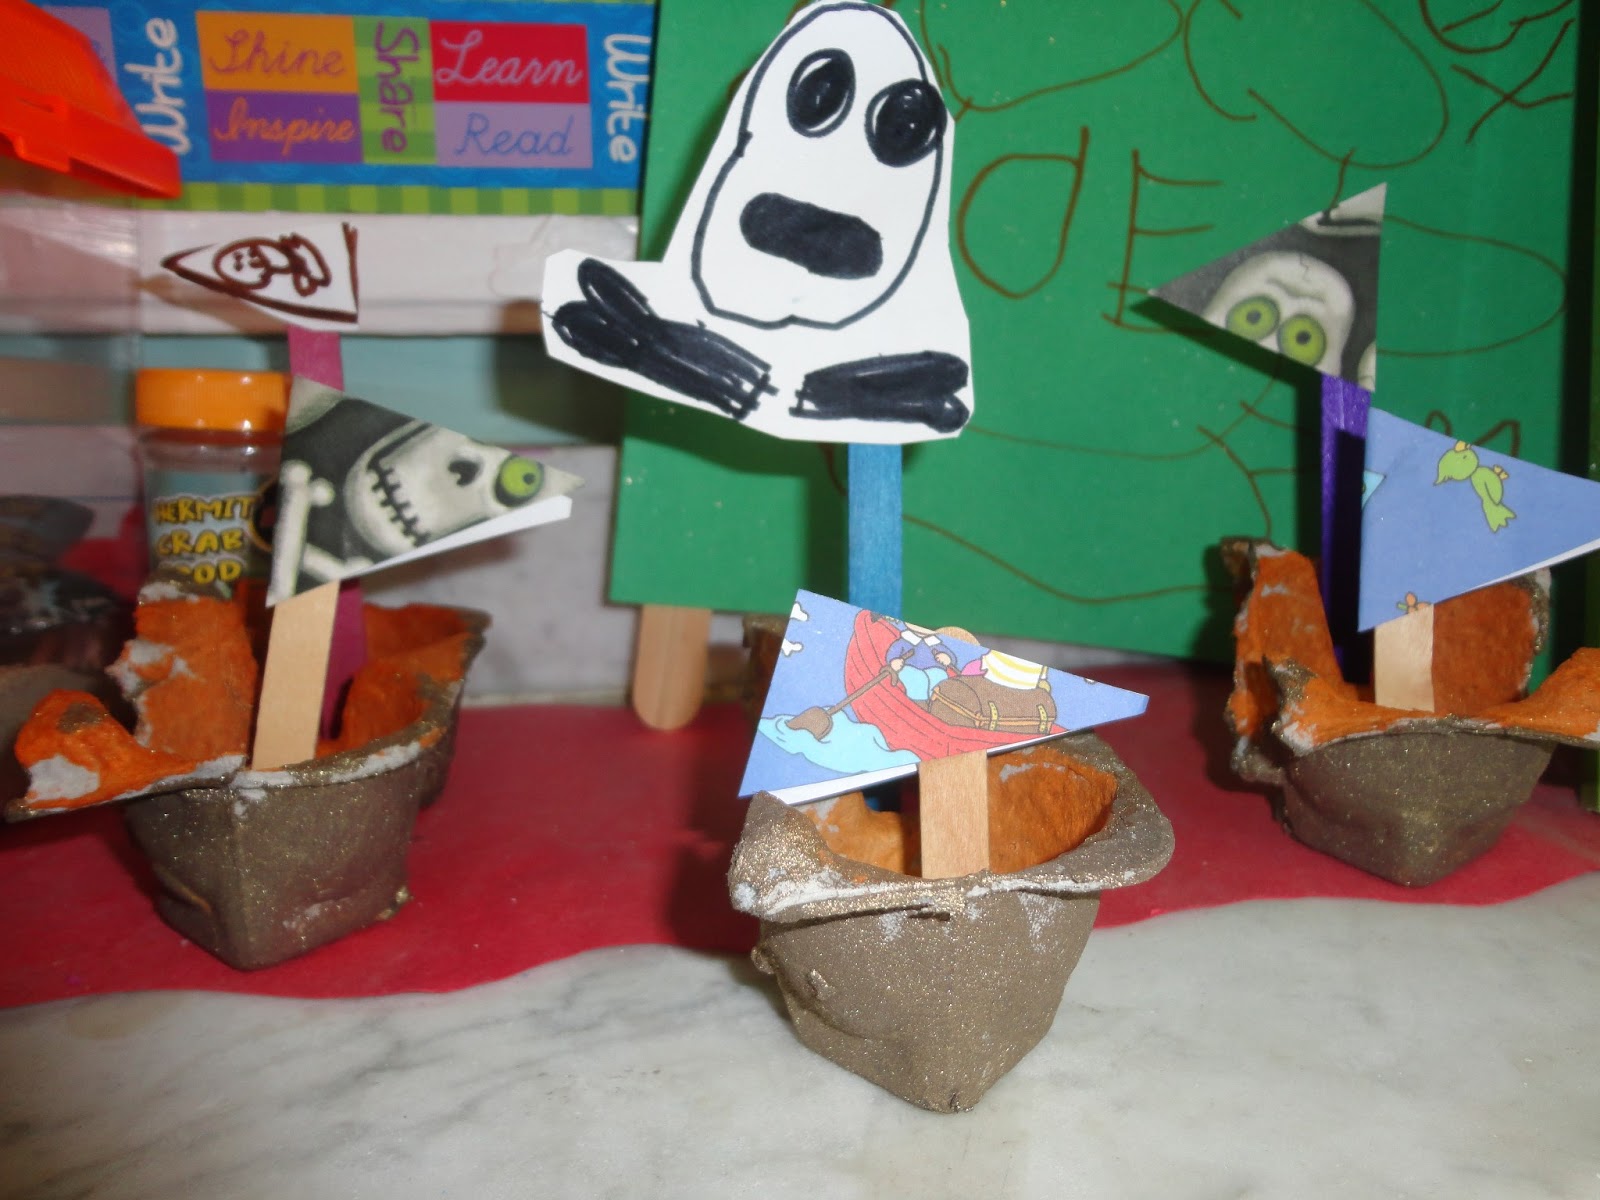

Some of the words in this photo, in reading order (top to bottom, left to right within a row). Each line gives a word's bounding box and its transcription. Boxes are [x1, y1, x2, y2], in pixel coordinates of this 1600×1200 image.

[209, 29, 346, 77] Shine
[435, 29, 583, 86] Learn
[122, 17, 191, 155] Write
[374, 20, 420, 154] Share
[603, 33, 652, 163] Write
[214, 96, 356, 157] Inspire
[455, 111, 576, 156] Read
[154, 497, 253, 523] HERMIT
[157, 529, 244, 555] CRAB
